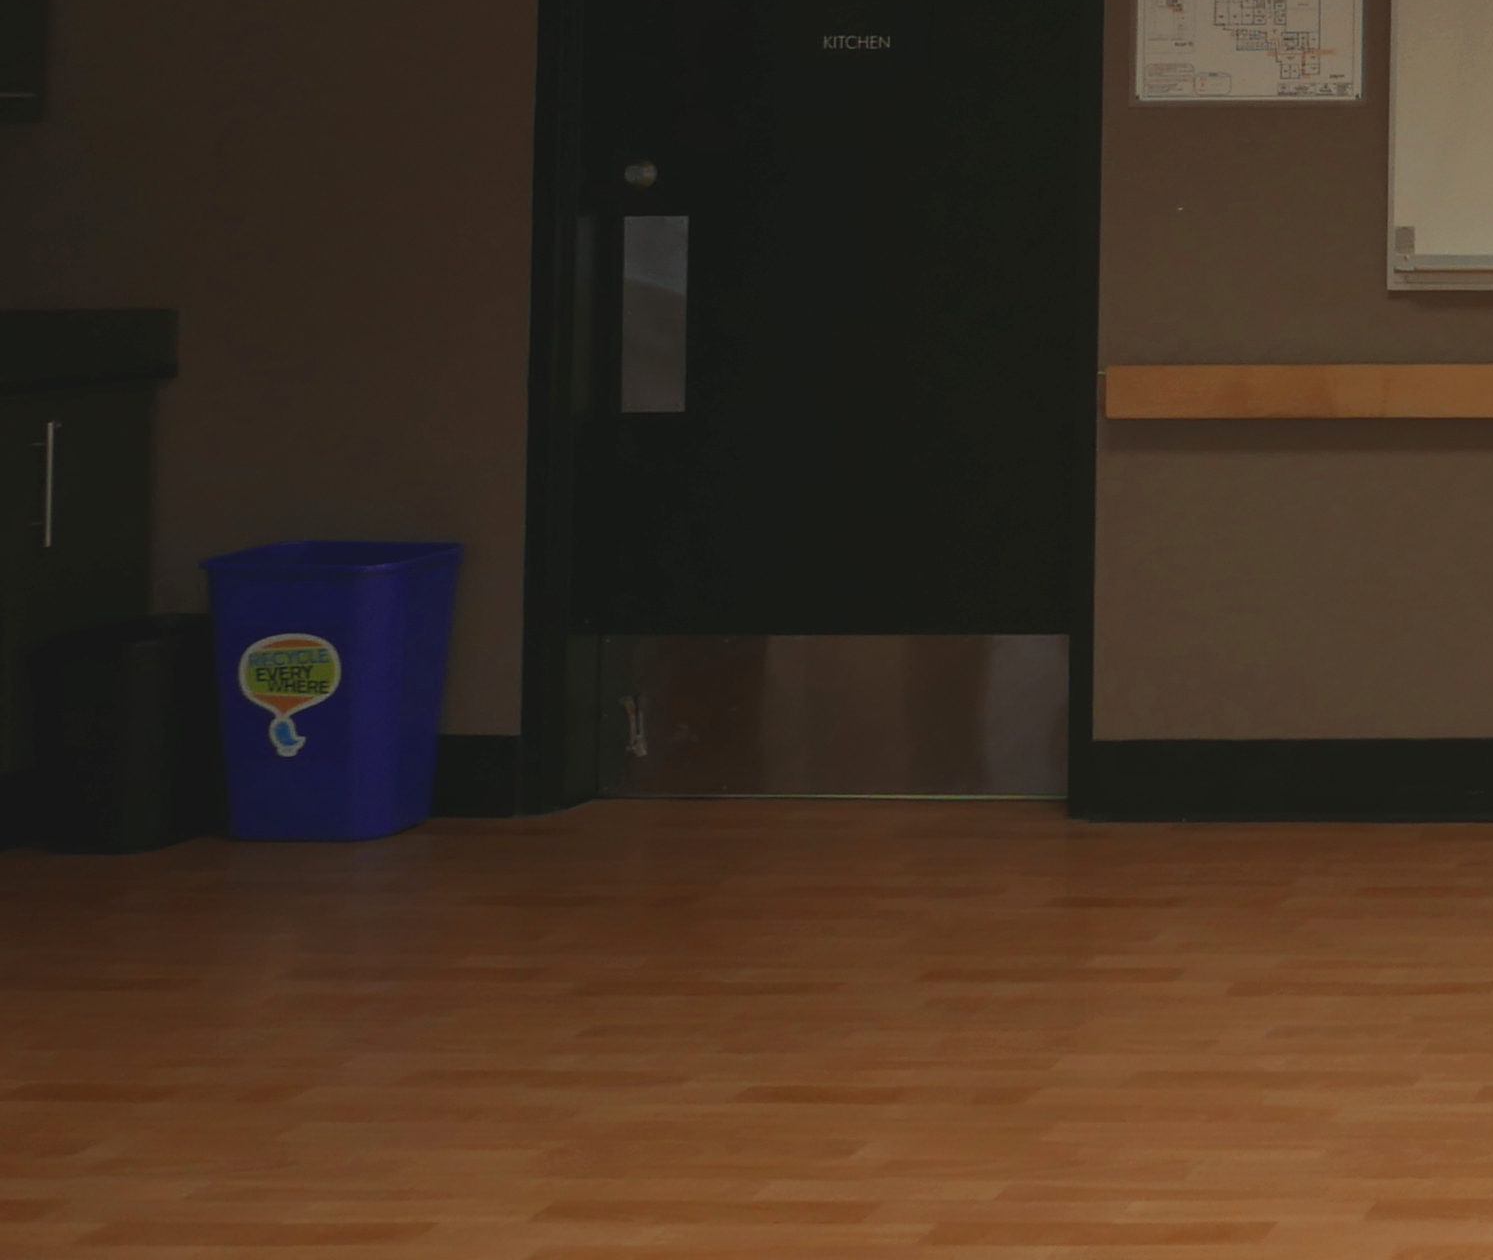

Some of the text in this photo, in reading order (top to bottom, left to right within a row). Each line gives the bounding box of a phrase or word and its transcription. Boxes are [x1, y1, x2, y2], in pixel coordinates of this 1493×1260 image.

[823, 35, 891, 49] KITCHEN
[248, 648, 330, 667] RECYCLE
[256, 665, 314, 682] EVERY
[267, 680, 330, 694] WHERE
